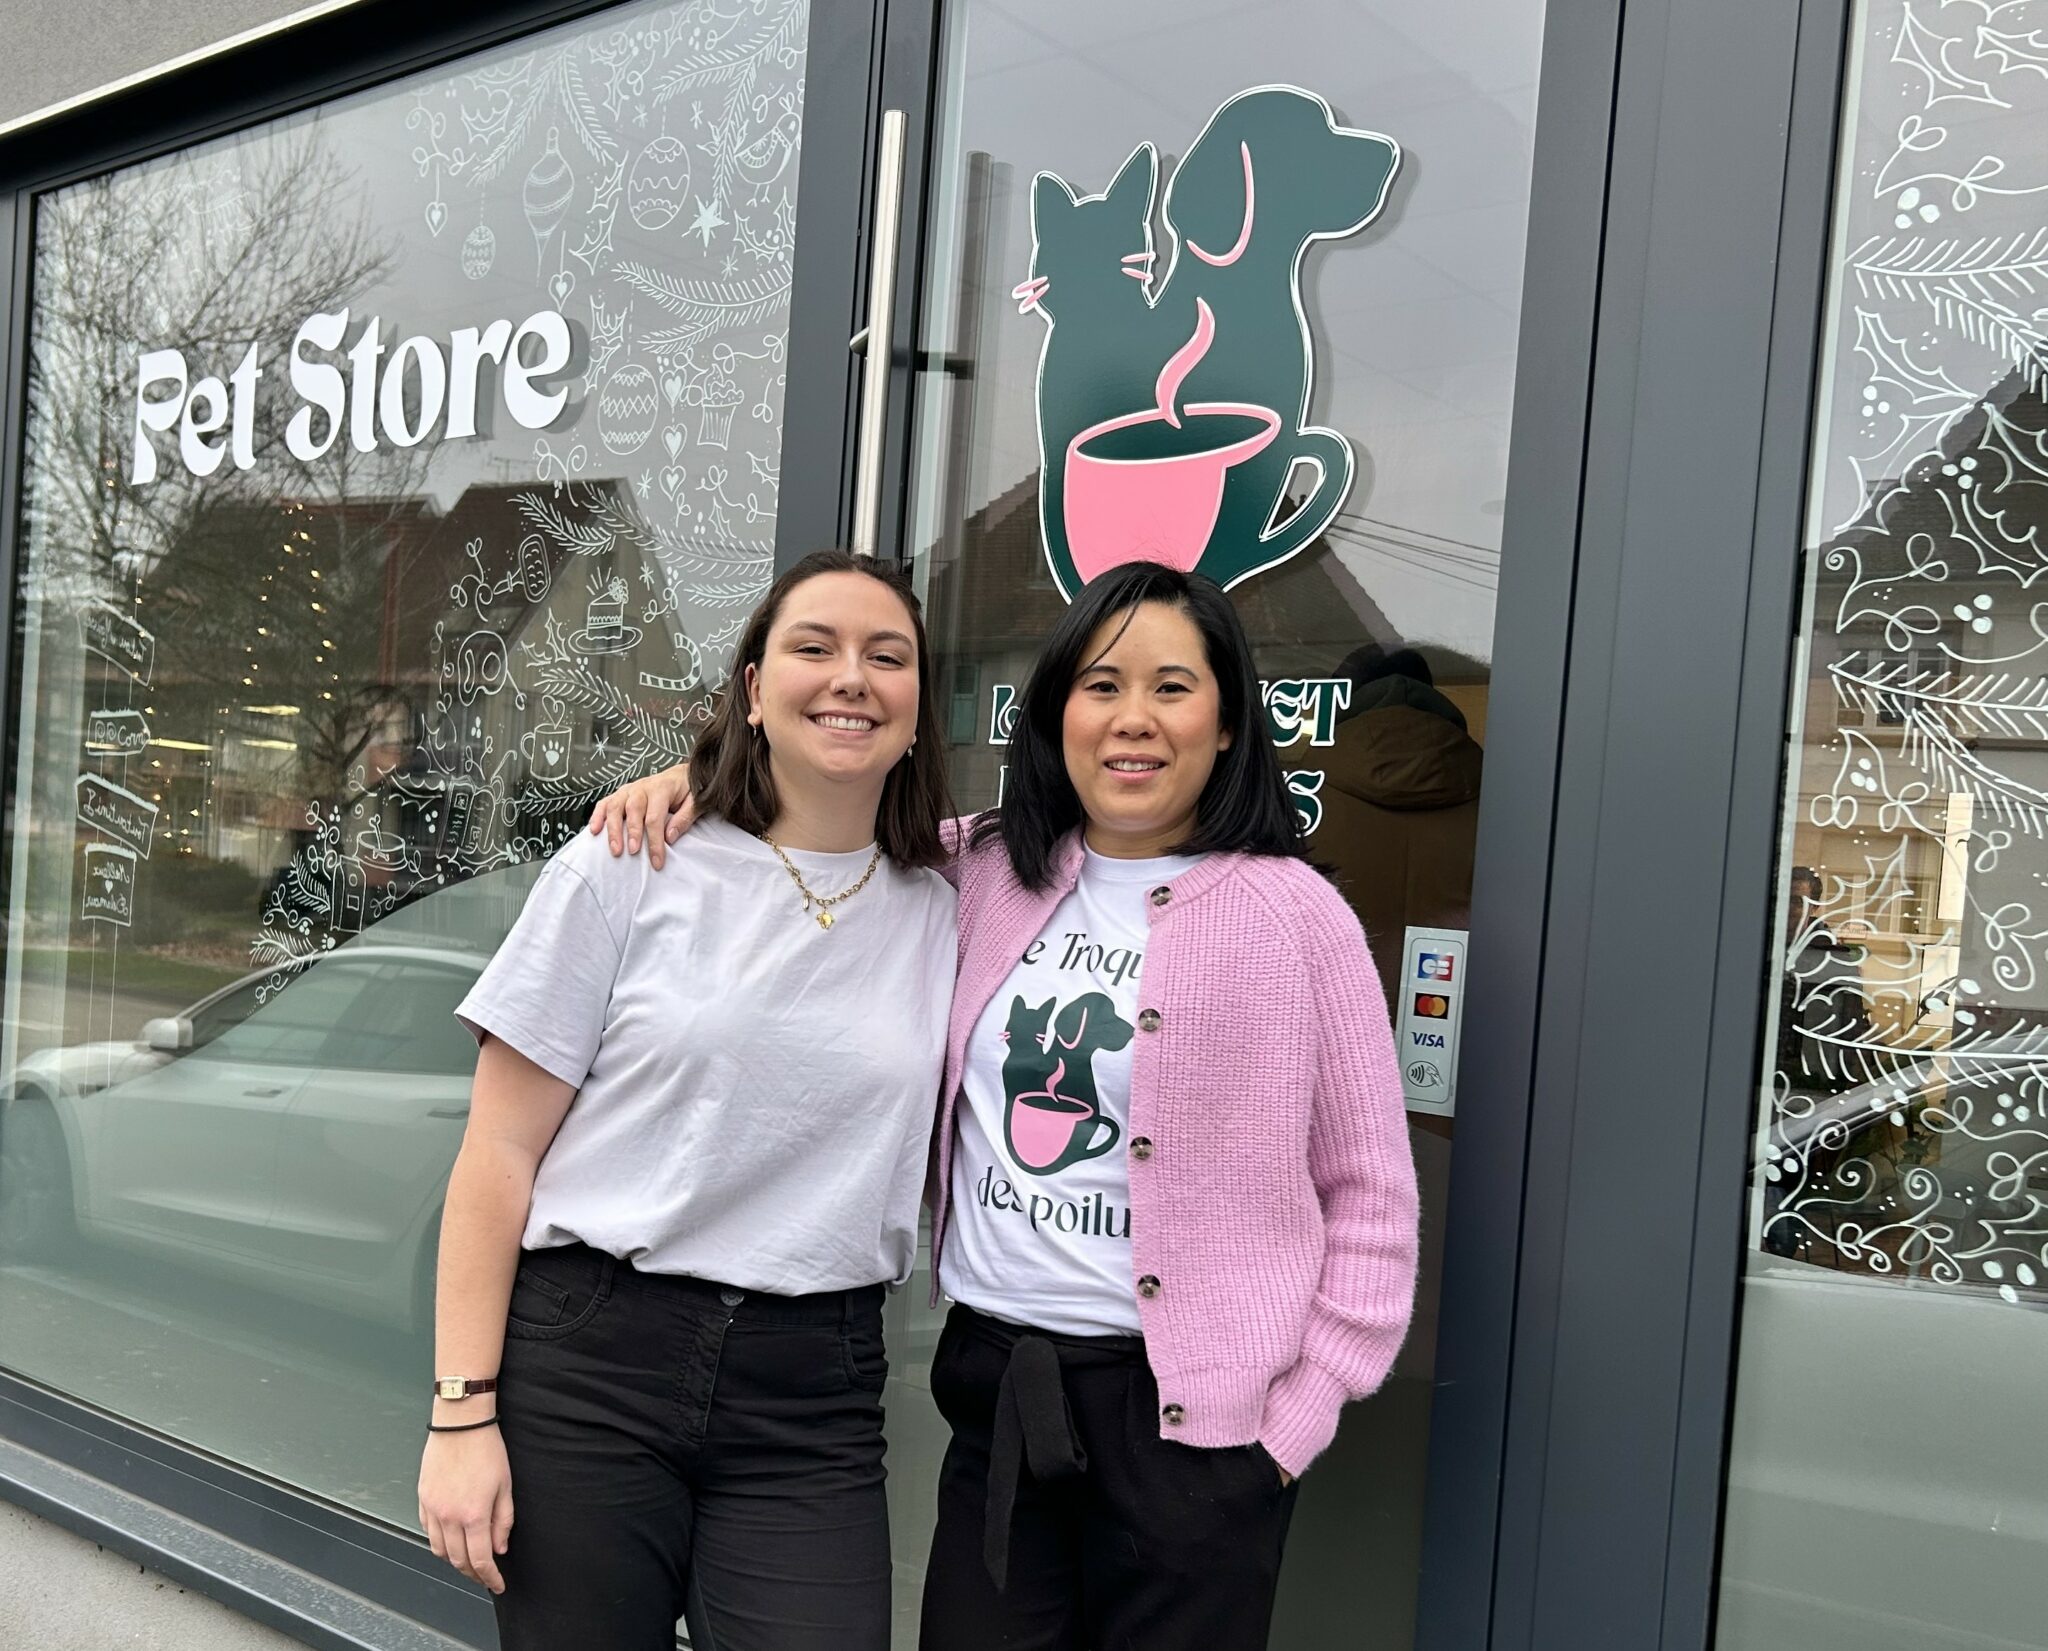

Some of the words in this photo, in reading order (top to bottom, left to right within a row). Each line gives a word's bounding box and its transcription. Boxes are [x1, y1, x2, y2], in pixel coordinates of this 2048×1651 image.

[131, 341, 263, 485] Pet
[285, 307, 571, 462] Store
[1022, 940, 1046, 965] e
[1059, 933, 1142, 986] Troqu
[1411, 1032, 1445, 1048] VISA
[1030, 1192, 1131, 1238] poilu
